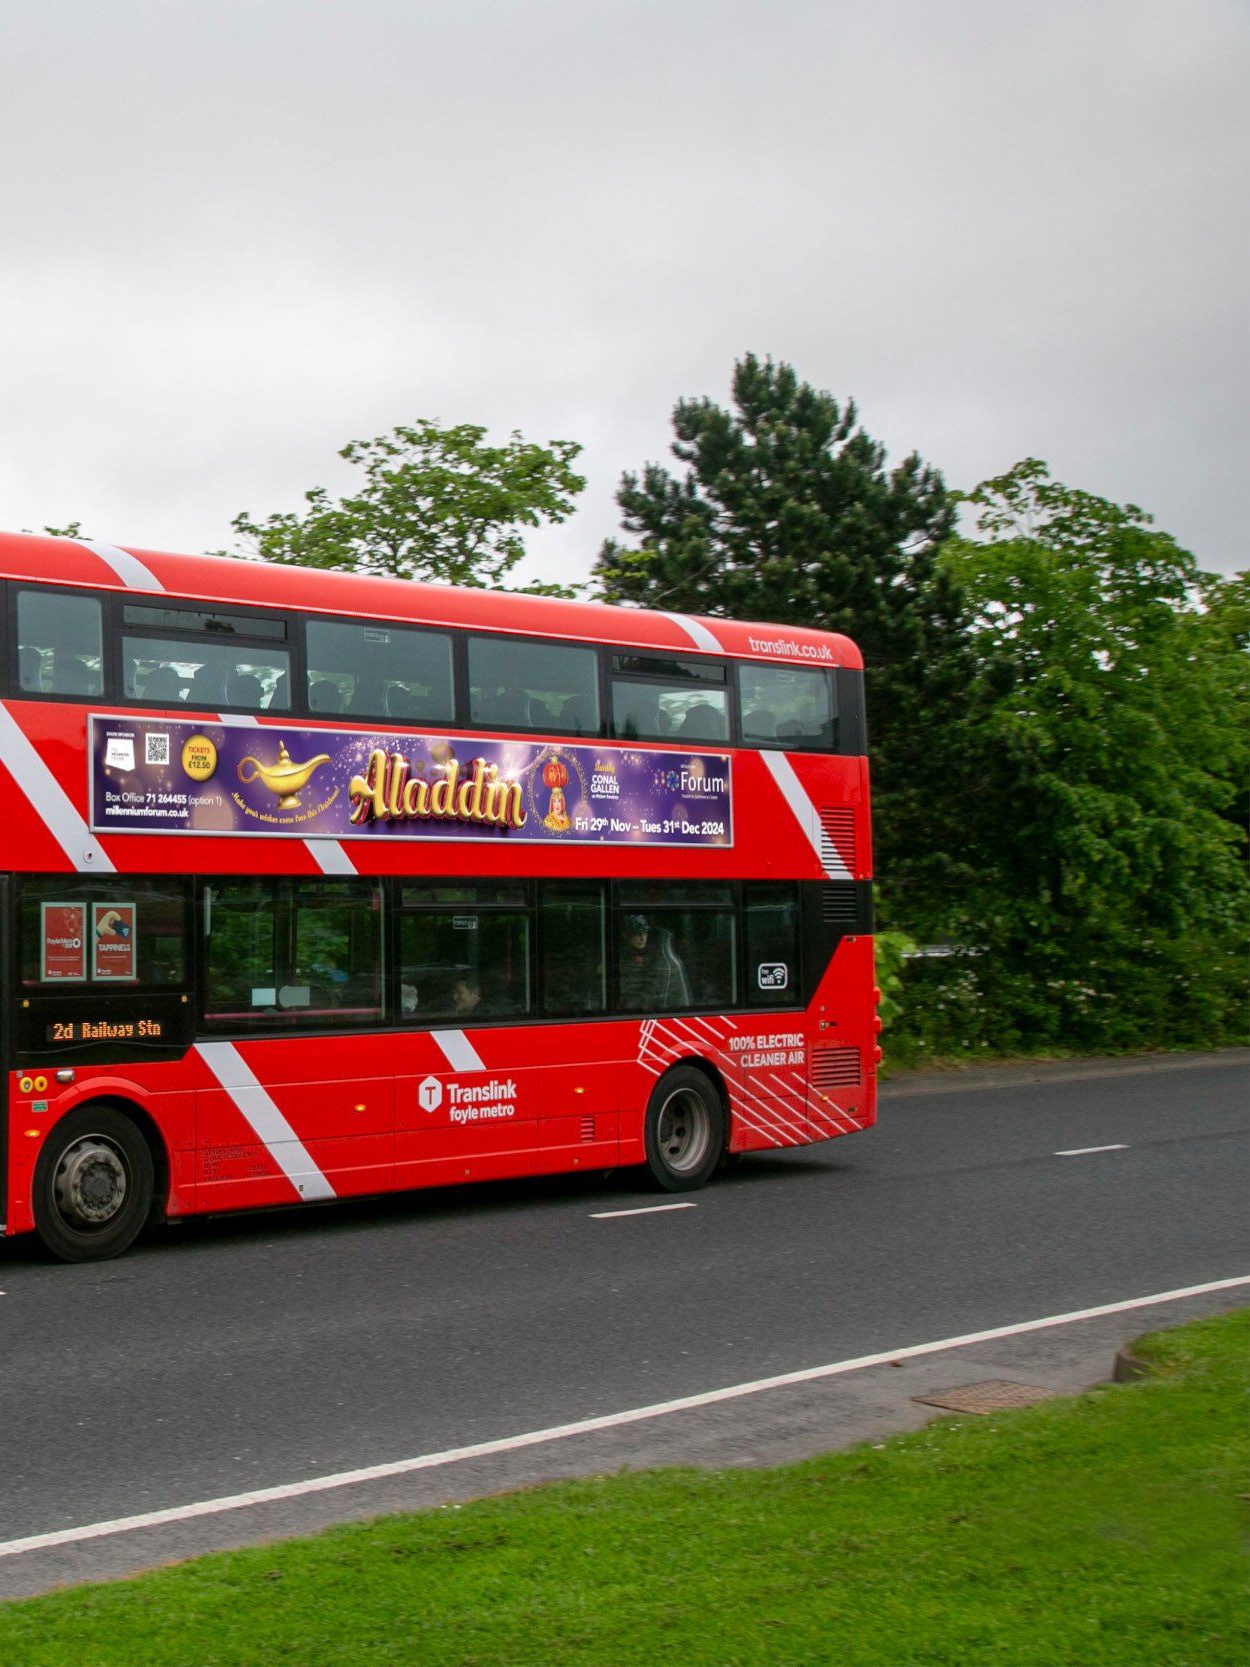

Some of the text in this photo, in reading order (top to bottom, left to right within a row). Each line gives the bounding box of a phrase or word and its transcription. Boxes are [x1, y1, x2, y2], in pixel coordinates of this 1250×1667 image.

[748, 635, 834, 660] translink.co.uk
[188, 746, 210, 754] TICKETS
[188, 761, 210, 769] £12.50
[591, 774, 619, 785] CONAL
[680, 771, 724, 793] Forum
[348, 748, 527, 830] Aladdin
[590, 783, 620, 795] GALLEN
[105, 791, 223, 807] Box Office 71 264455 (option 1)
[231, 792, 246, 809] Make
[244, 807, 259, 819] your
[259, 813, 278, 824] wishes
[279, 816, 294, 824] come
[295, 814, 307, 822] true
[307, 808, 318, 819] this
[105, 805, 189, 817] millenniumforum.co.uk
[575, 817, 588, 831] Fri
[590, 817, 608, 832] 29th
[610, 818, 631, 832] Nov
[640, 819, 661, 833] Tues
[663, 820, 680, 833] 31st
[681, 821, 700, 834] Dec
[701, 822, 724, 835] 2024
[98, 943, 132, 952] TAPPINESS
[761, 974, 775, 985] wifi
[53, 1020, 161, 1040] 2d Railway Stn
[728, 1033, 804, 1051] 100% ELECTRIC
[740, 1050, 805, 1068] CLEANER AIR
[446, 1079, 517, 1104] Translink
[450, 1102, 515, 1125] foyle metro
